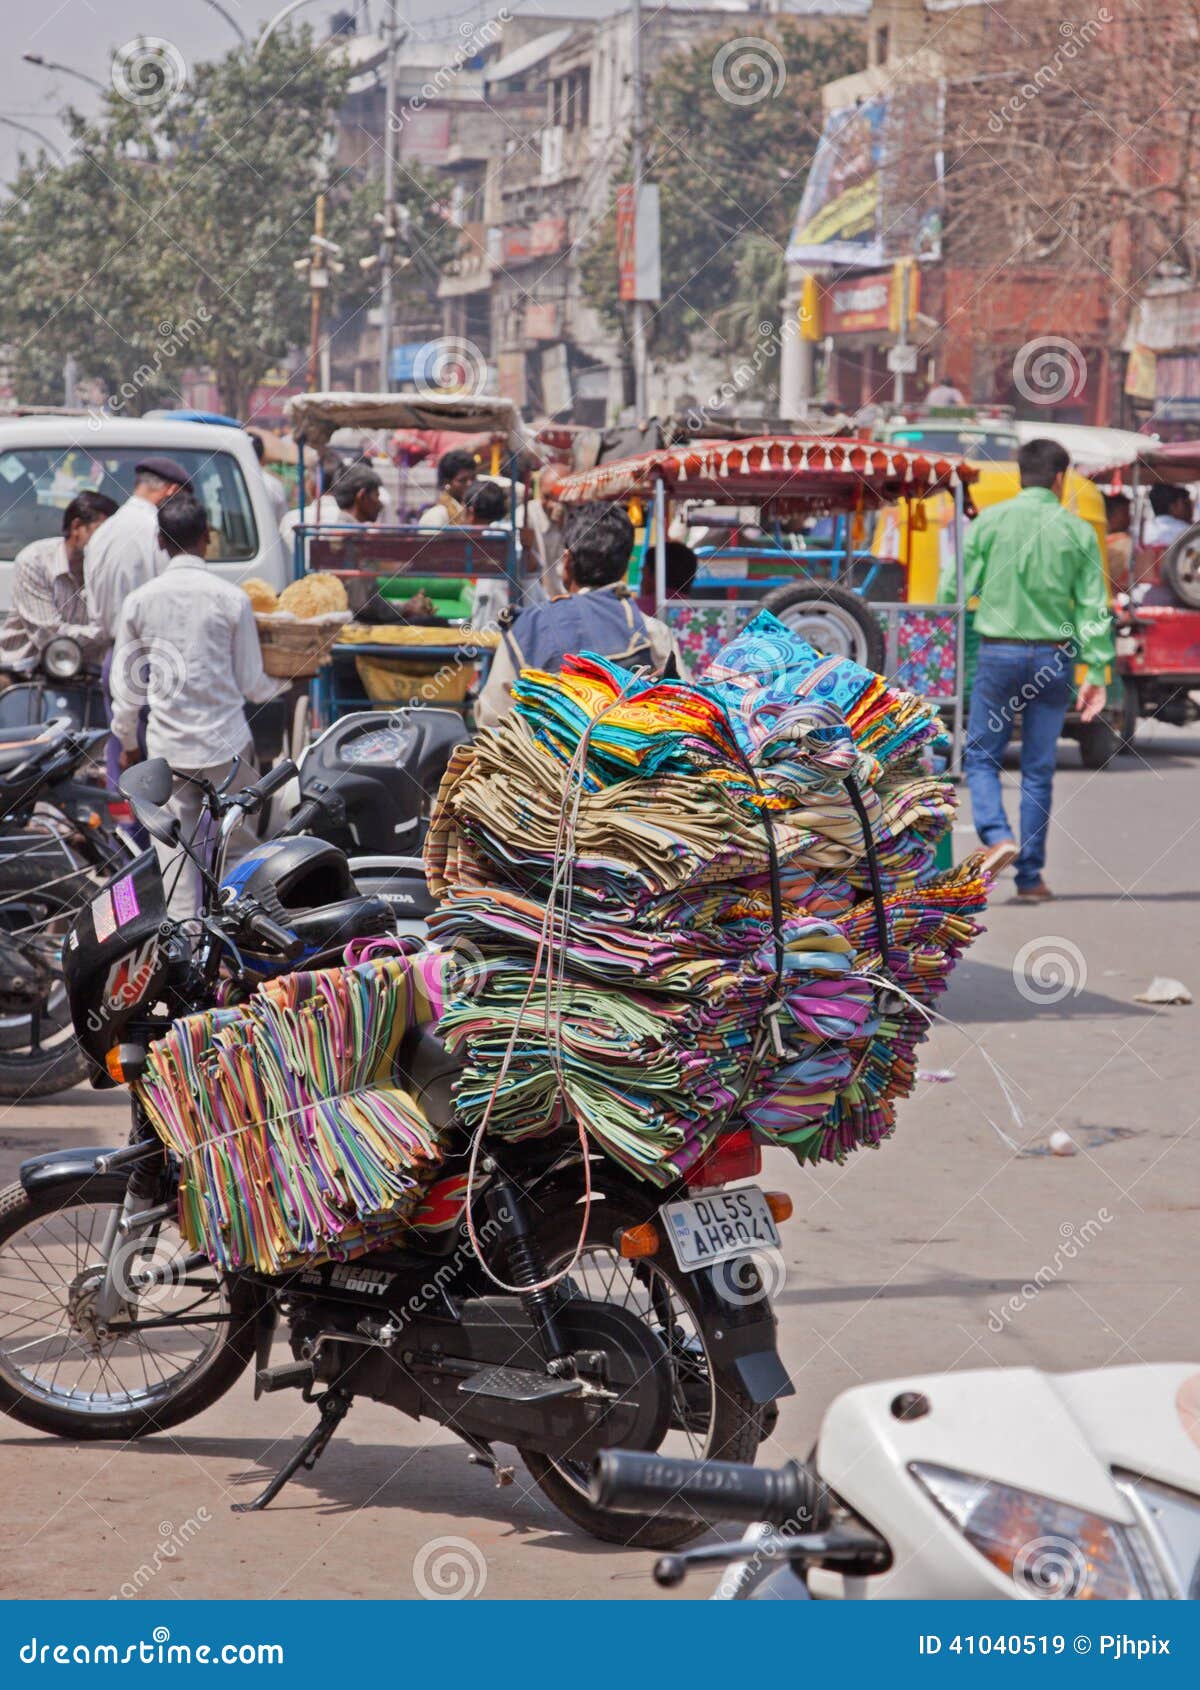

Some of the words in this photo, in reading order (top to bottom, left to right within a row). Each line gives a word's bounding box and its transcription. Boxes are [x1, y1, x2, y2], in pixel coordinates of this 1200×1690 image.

[694, 1194, 752, 1226] DL5S
[331, 1264, 398, 1285] HEAVY
[345, 1278, 389, 1296] DUTY
